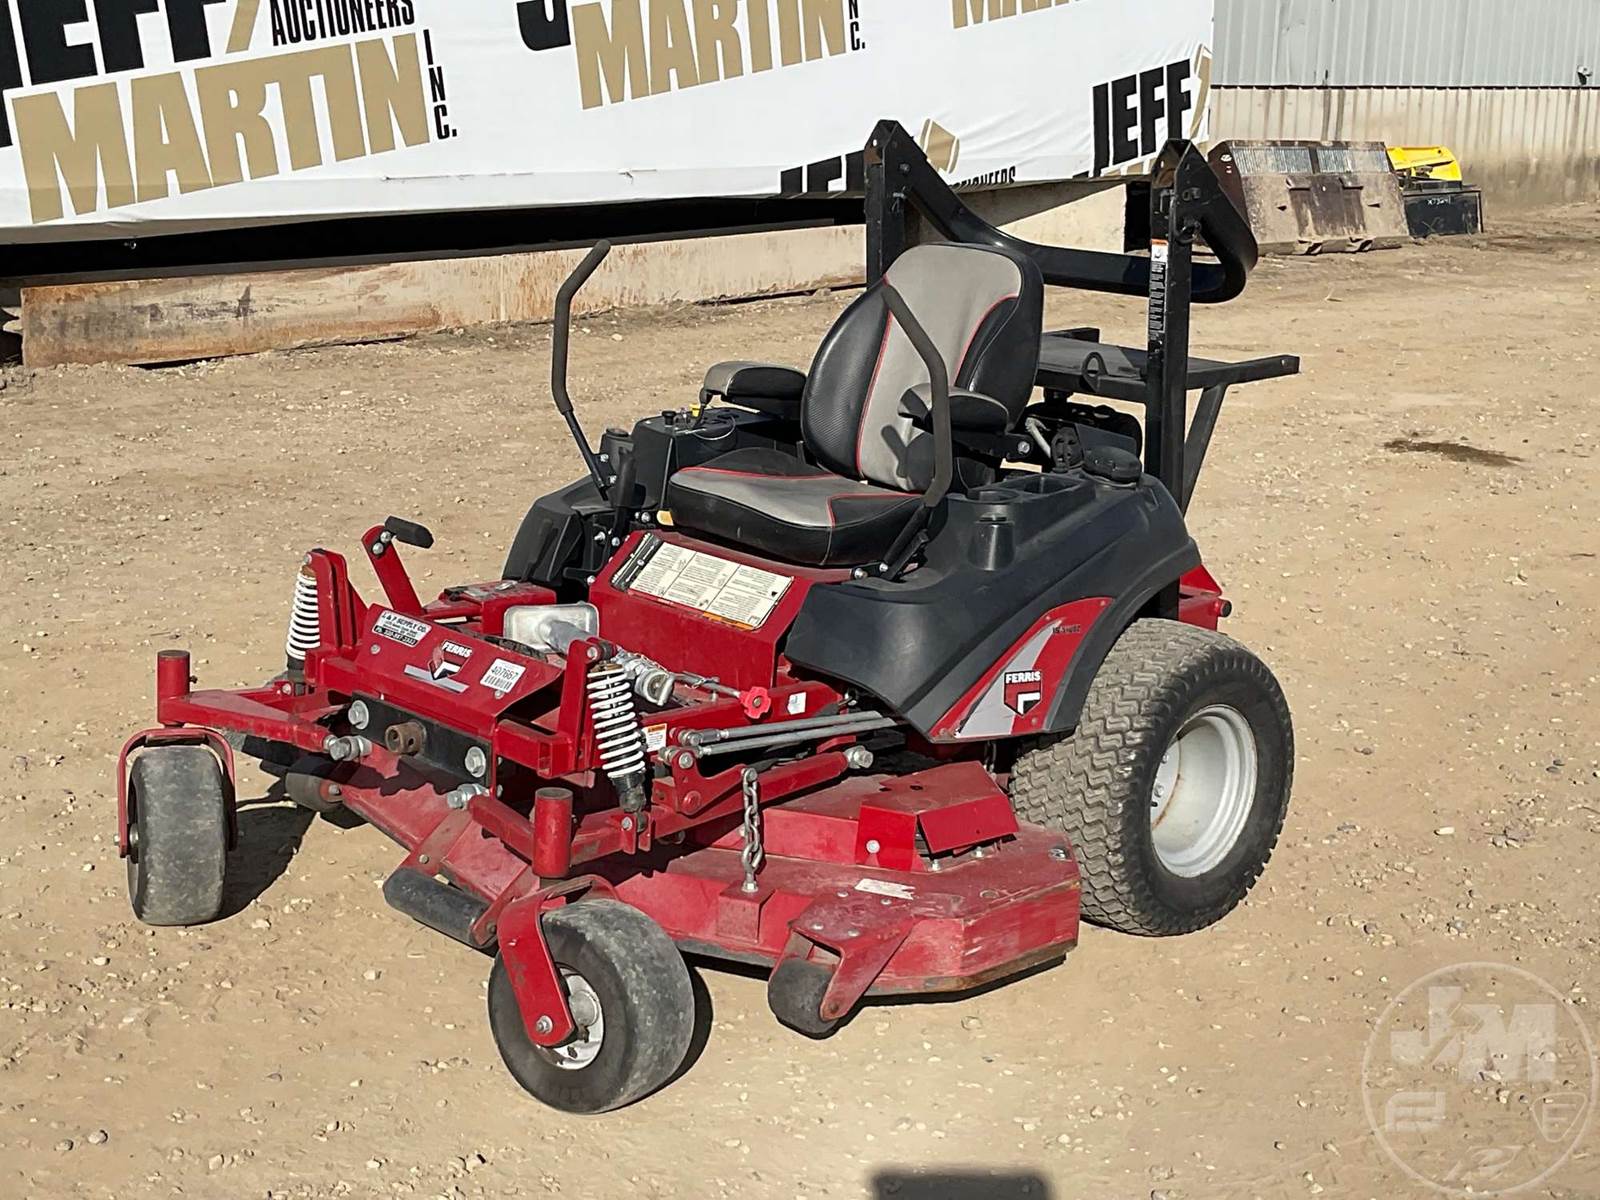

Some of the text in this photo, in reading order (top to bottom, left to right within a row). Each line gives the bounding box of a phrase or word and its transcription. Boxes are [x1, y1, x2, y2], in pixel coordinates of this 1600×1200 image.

[424, 29, 457, 140] INC.
[571, 0, 846, 110] MARTIN
[12, 33, 430, 224] MARTIN
[1072, 59, 1191, 178] JEFF
[441, 641, 473, 658] FERRIS
[1005, 671, 1041, 684] FERRIS
